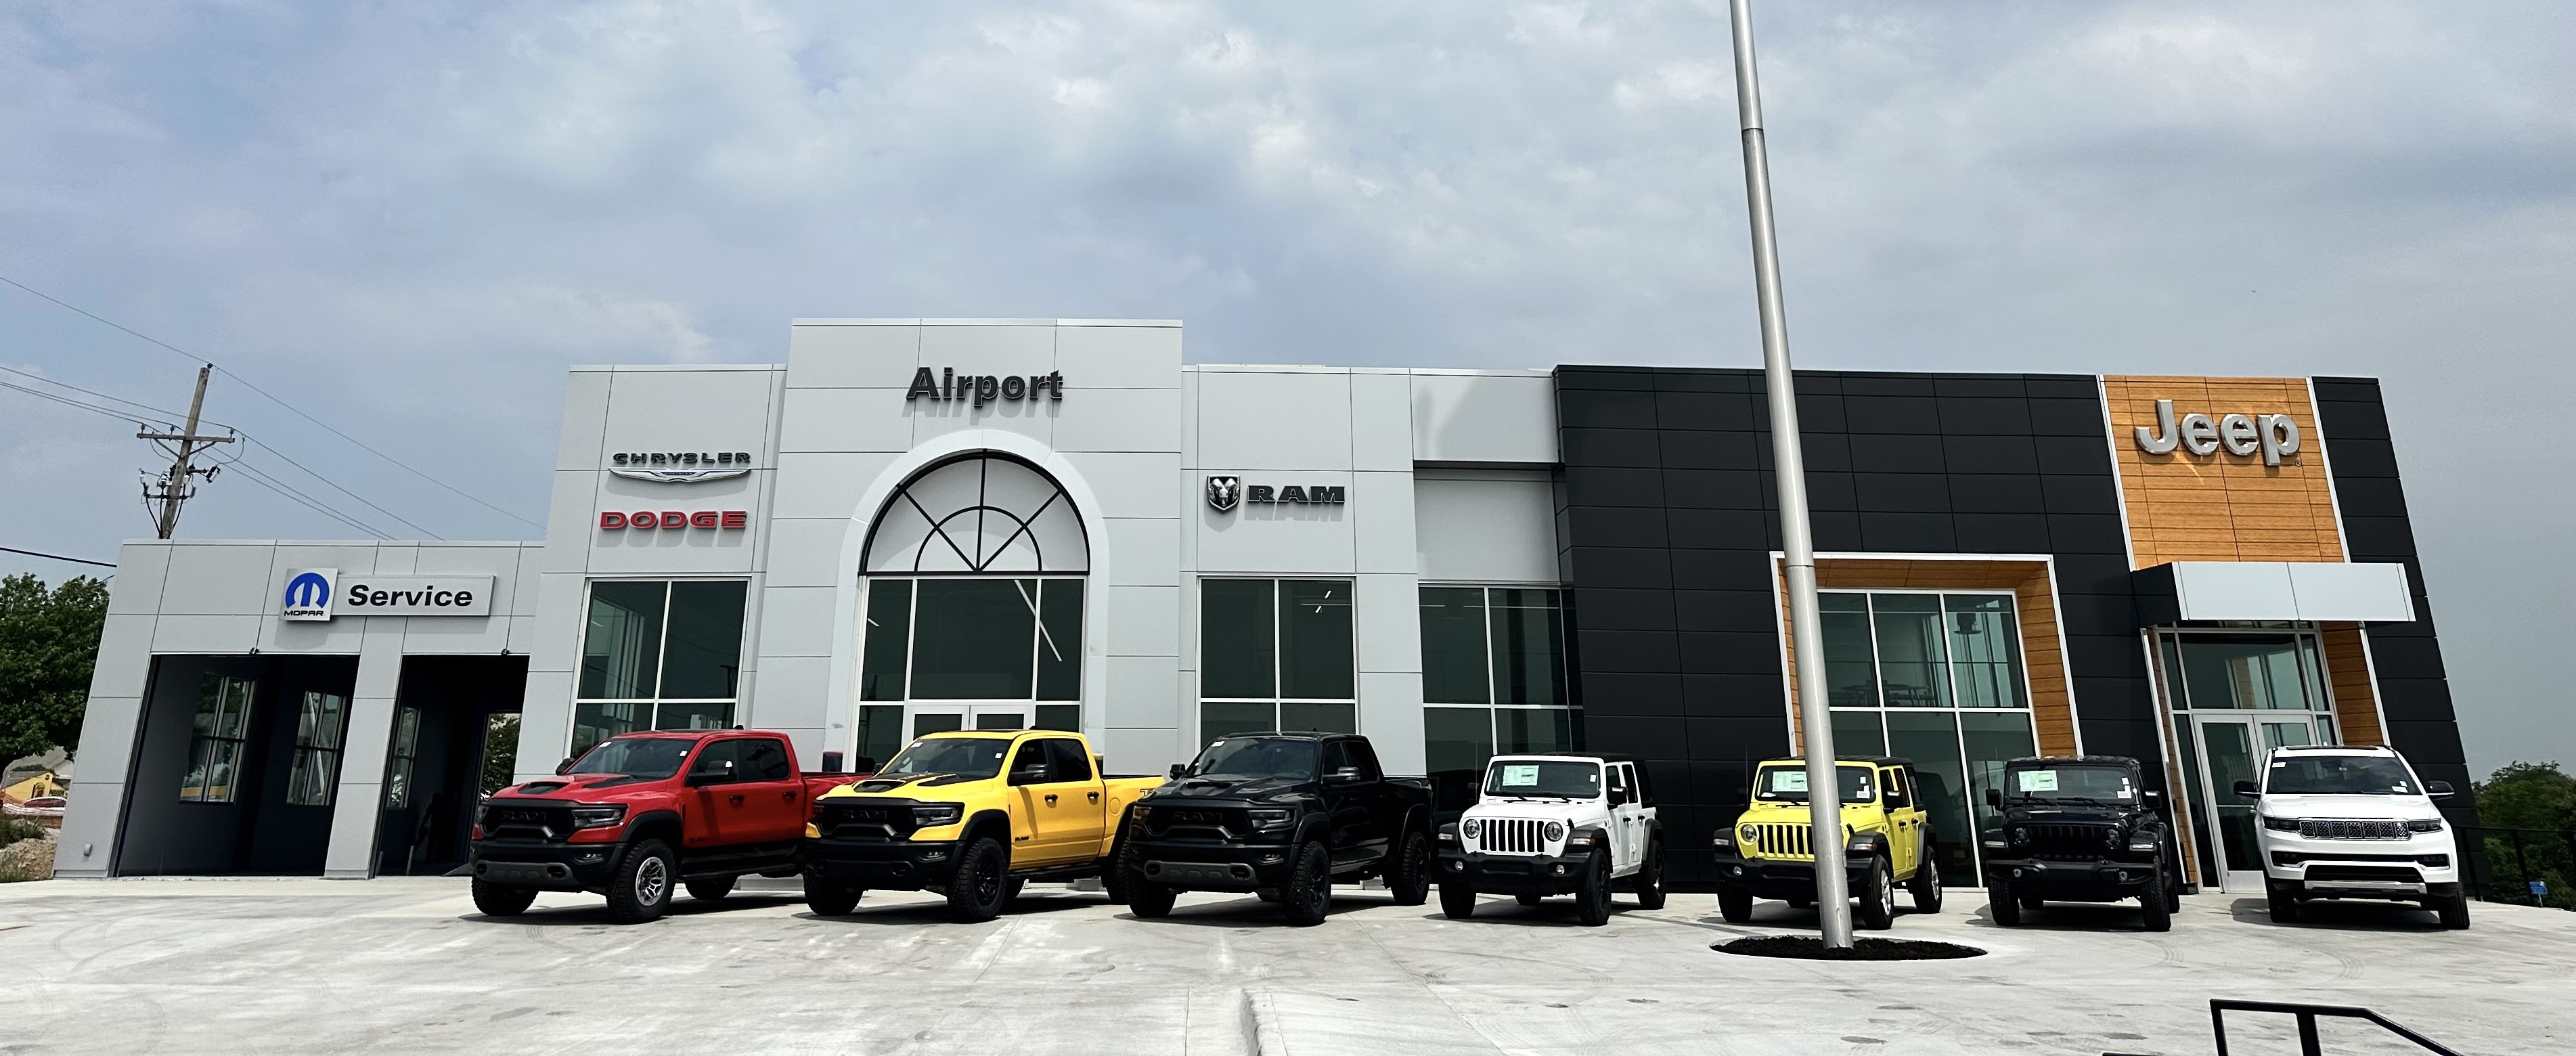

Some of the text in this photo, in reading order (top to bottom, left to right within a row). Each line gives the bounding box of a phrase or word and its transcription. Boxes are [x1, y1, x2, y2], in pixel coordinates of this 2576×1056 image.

[906, 367, 1063, 408] Airport
[2135, 399, 2300, 466] Jeep
[613, 452, 751, 464] CHRYSLER
[1247, 485, 1345, 504] RAM
[600, 511, 747, 530] DODGE
[348, 584, 472, 607] Service
[500, 810, 546, 820] RAM
[839, 810, 887, 819] RAM
[1170, 811, 1222, 821] RAM
